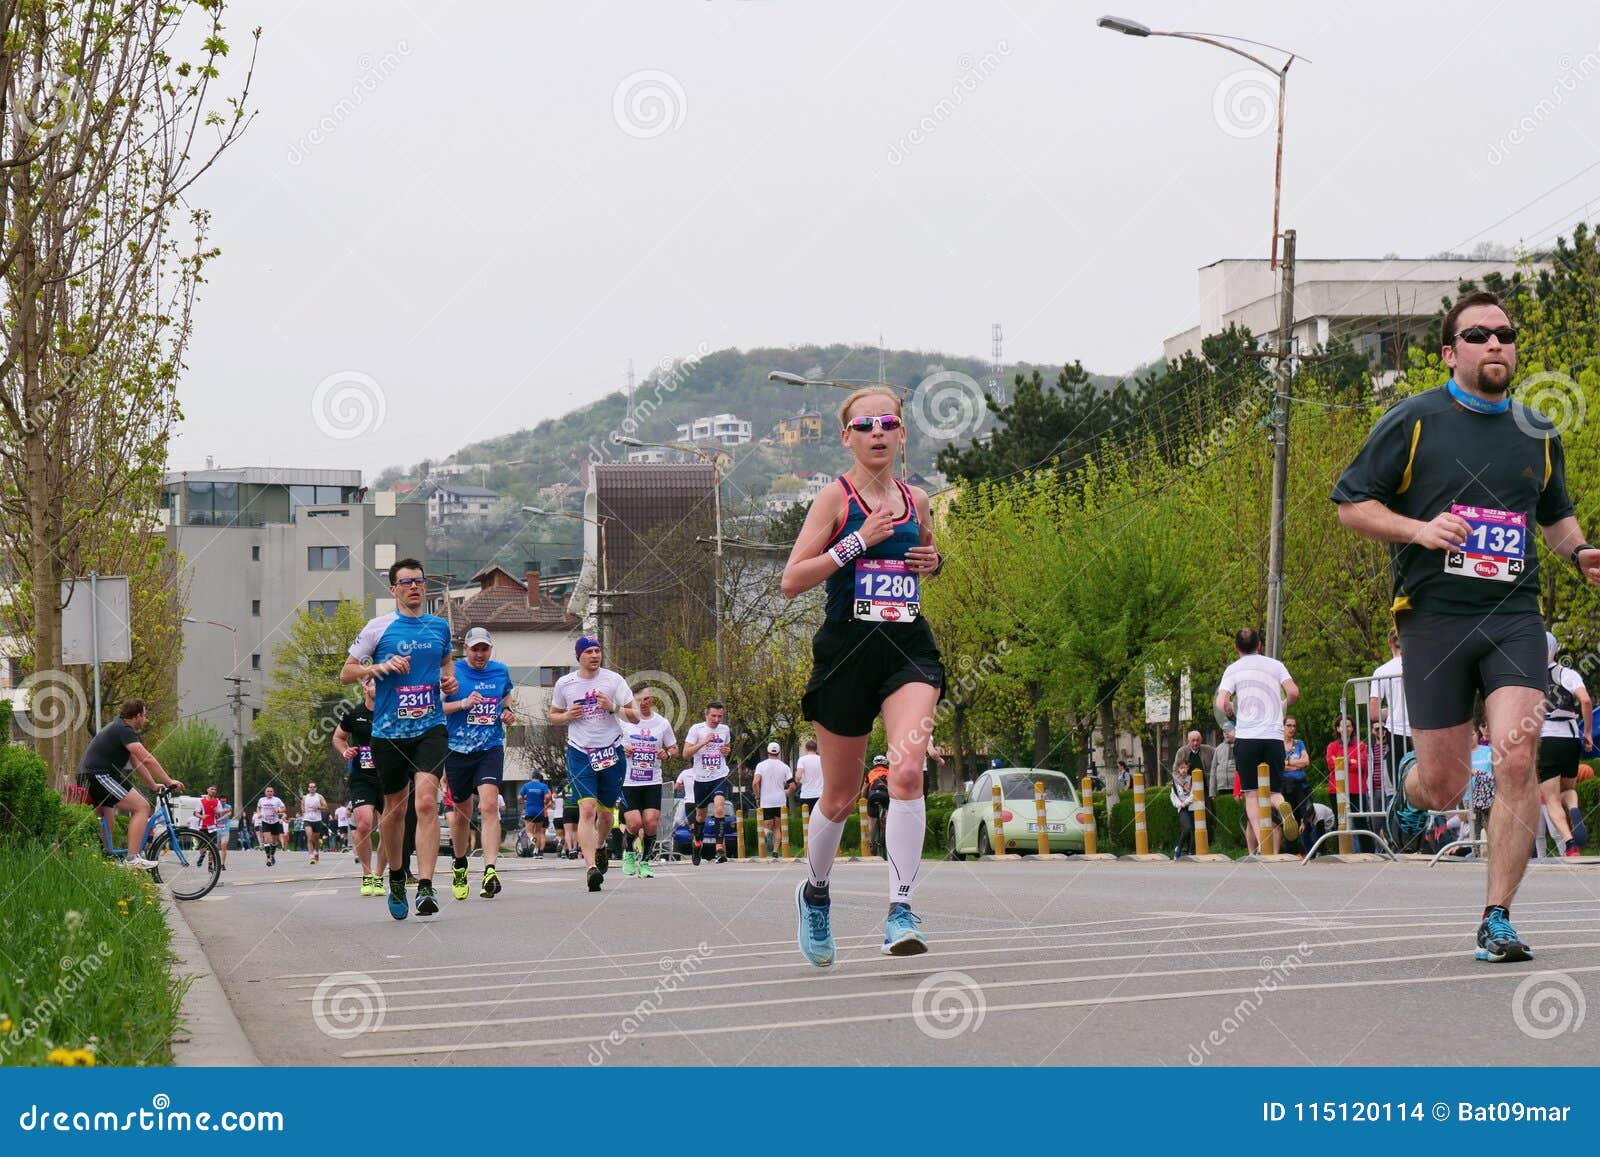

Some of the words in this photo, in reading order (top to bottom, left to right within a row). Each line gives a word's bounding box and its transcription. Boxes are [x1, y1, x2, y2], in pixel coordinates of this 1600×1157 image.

[1460, 525, 1520, 554] 132
[860, 573, 915, 598] 1280
[399, 692, 431, 707] 2311
[469, 704, 496, 714] 2312
[590, 746, 615, 762] 2140
[633, 752, 654, 761] 2363
[704, 757, 720, 765] 1112
